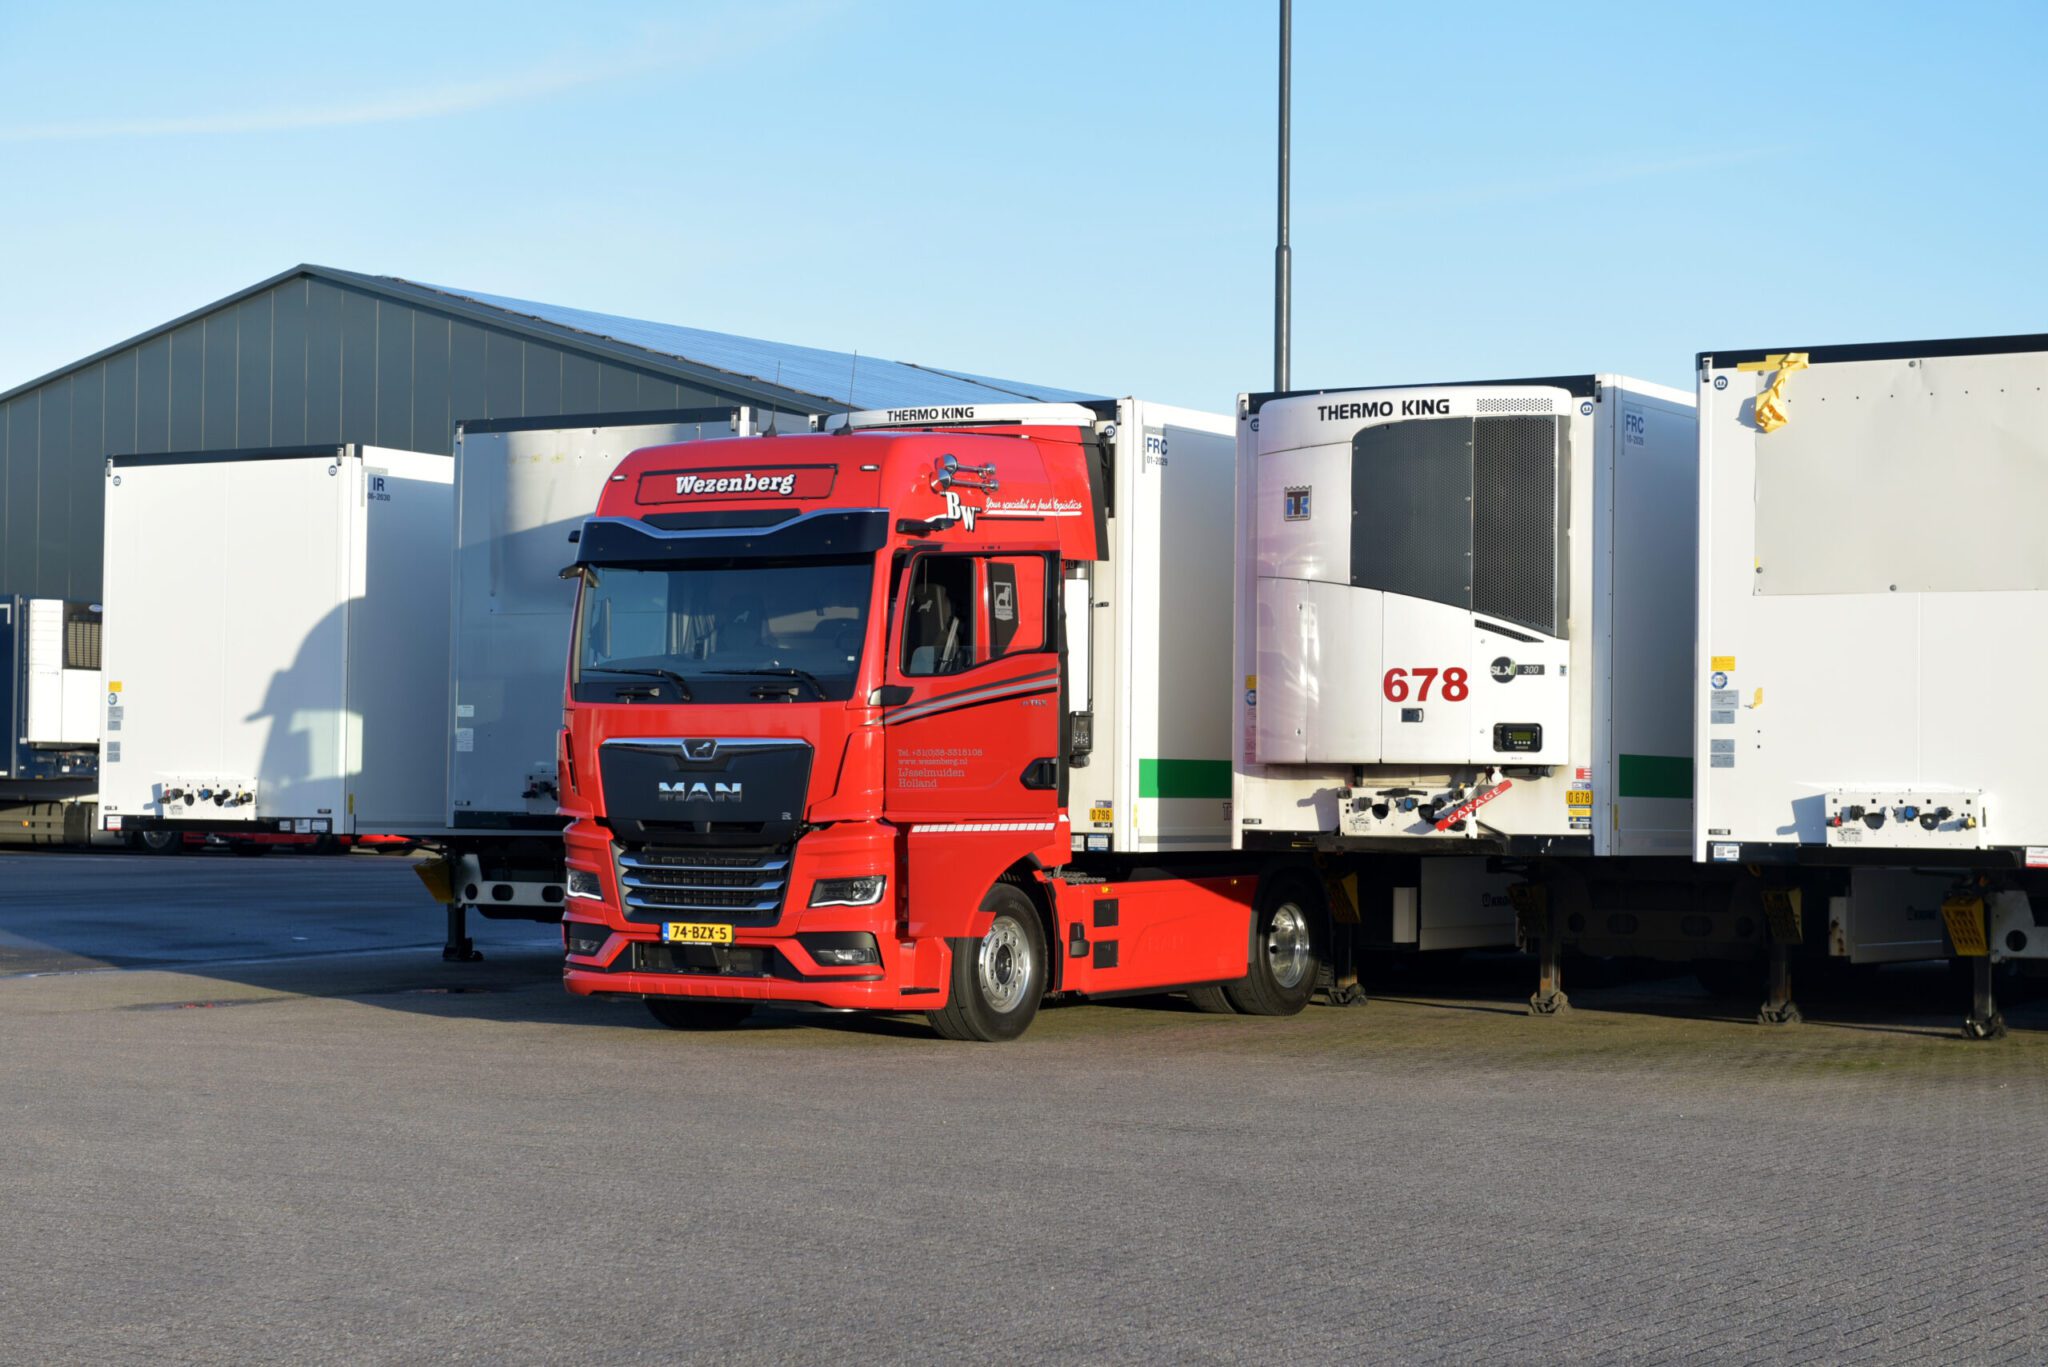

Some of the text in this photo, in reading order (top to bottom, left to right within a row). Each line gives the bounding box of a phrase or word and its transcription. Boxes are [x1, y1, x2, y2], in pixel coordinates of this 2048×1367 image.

[887, 407, 974, 422] THERMO KING
[1317, 399, 1450, 422] THERMO KING
[1625, 413, 1644, 434] FRC
[1146, 436, 1168, 455] FRC
[373, 477, 384, 491] IR
[675, 473, 796, 496] Wezenberg
[984, 497, 1001, 512] Your
[1523, 665, 1539, 674] 300
[1383, 667, 1469, 703] 678
[898, 778, 937, 788] Holland
[658, 782, 742, 802] MAN
[1575, 792, 1590, 804] 678
[1447, 786, 1502, 823] GARAGE
[1097, 809, 1110, 821] 796
[672, 925, 727, 940] 74-BZX-5
